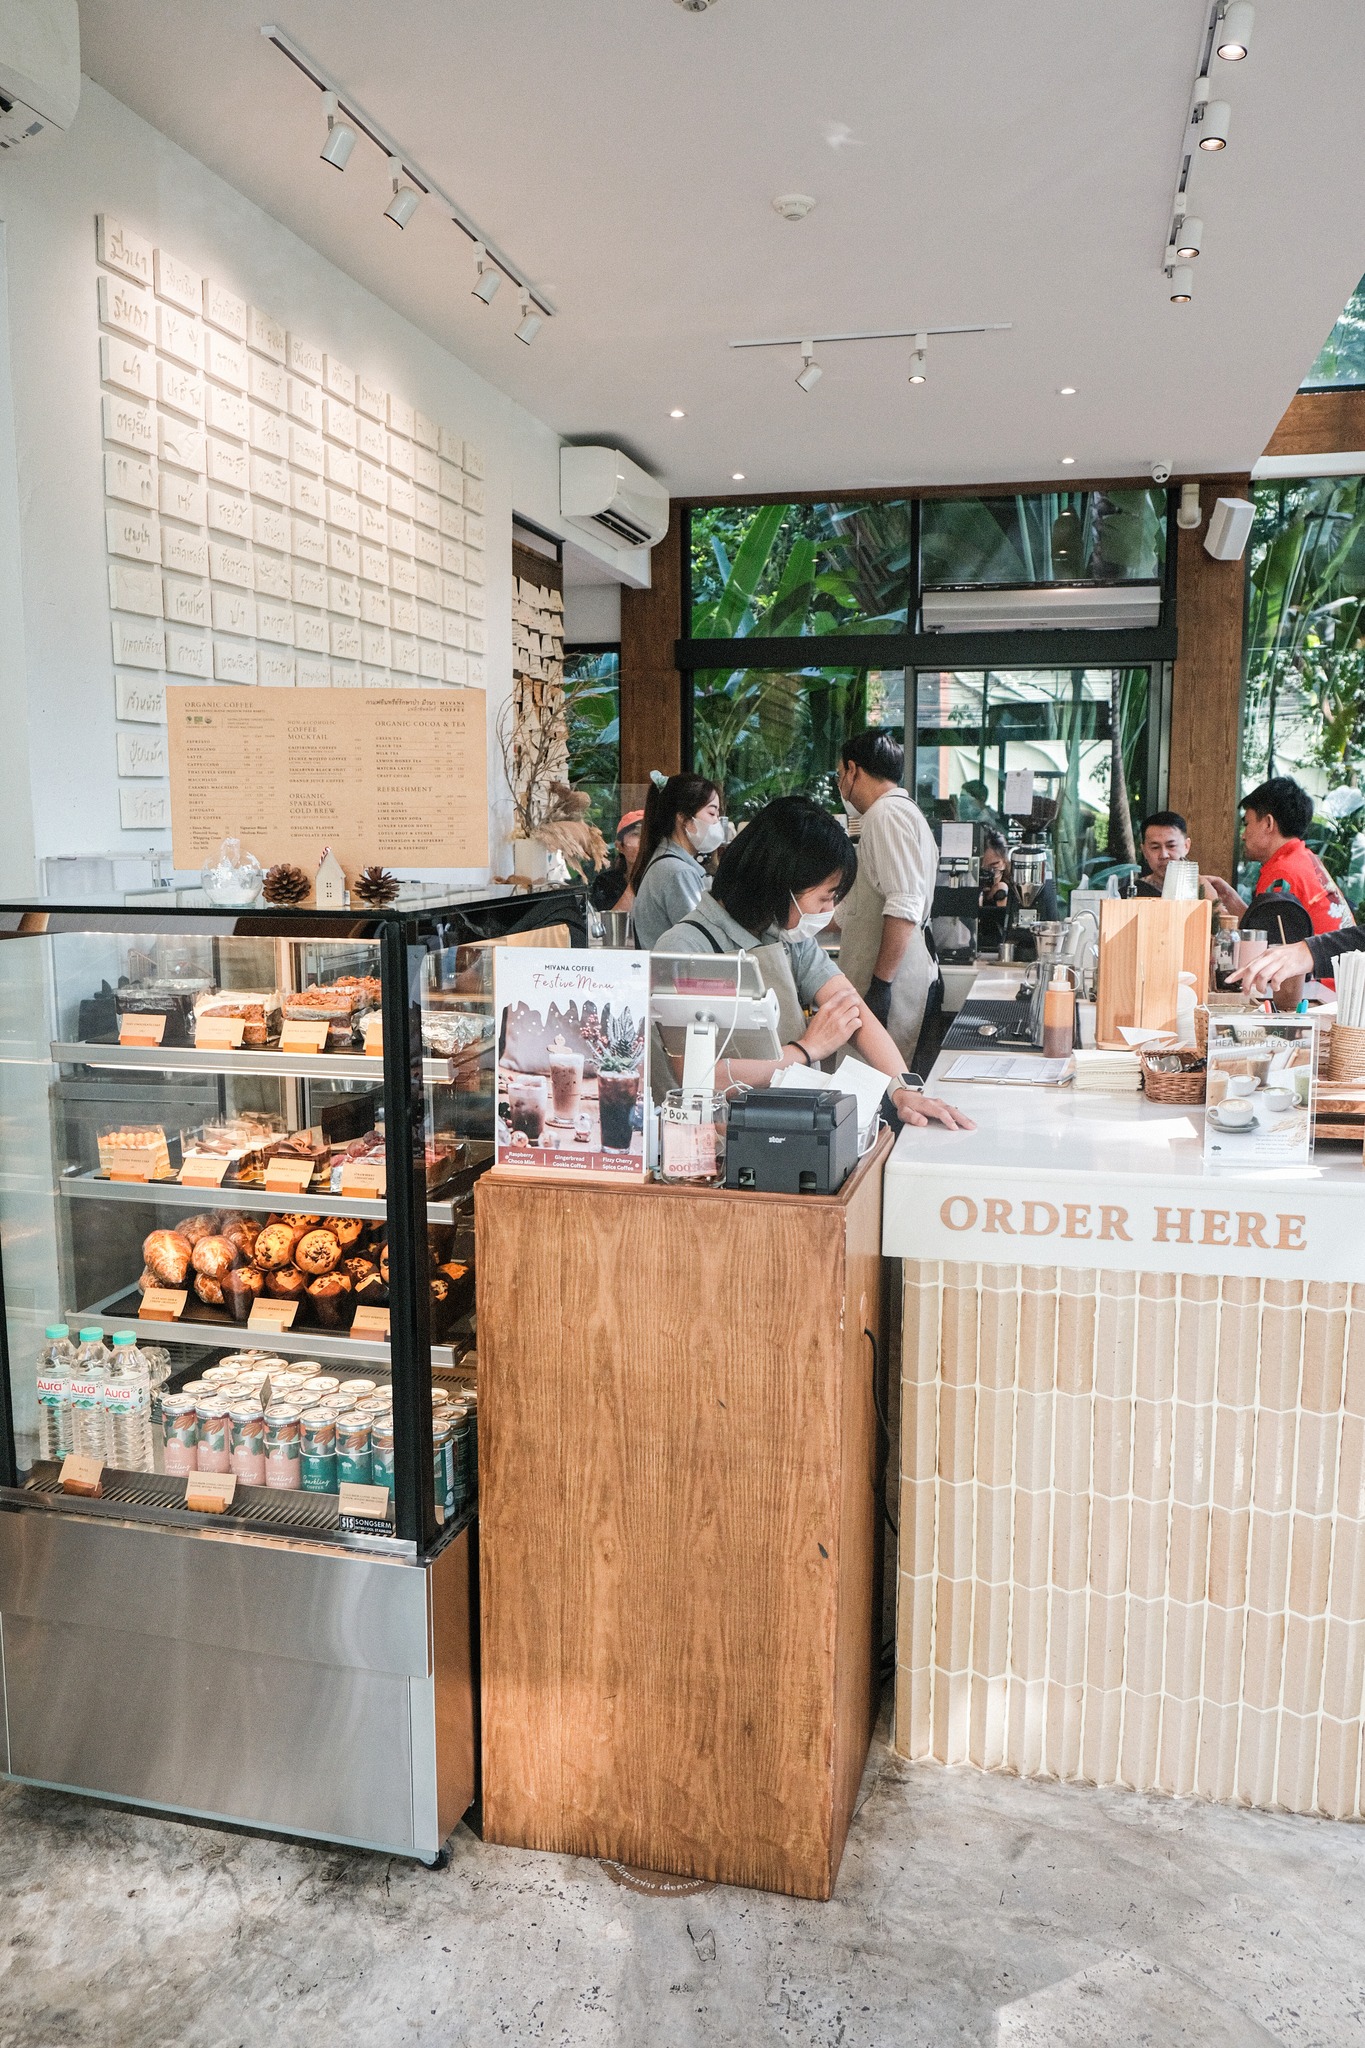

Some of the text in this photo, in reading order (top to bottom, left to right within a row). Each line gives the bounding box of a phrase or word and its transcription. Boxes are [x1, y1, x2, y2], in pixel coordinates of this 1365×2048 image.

[533, 973, 614, 992] Festive Menu
[1260, 1040, 1307, 1048] PLEASURE
[669, 1109, 689, 1120] BOX
[508, 1151, 534, 1160] Raspberry
[554, 1154, 585, 1163] Gingerbread
[940, 1195, 1308, 1251] ORDER HERE
[37, 1380, 62, 1391] Aura
[71, 1383, 96, 1394] Aura
[105, 1388, 131, 1399] Aura
[302, 1474, 331, 1487] Sparkling
[355, 1518, 392, 1529] SONGSERM
